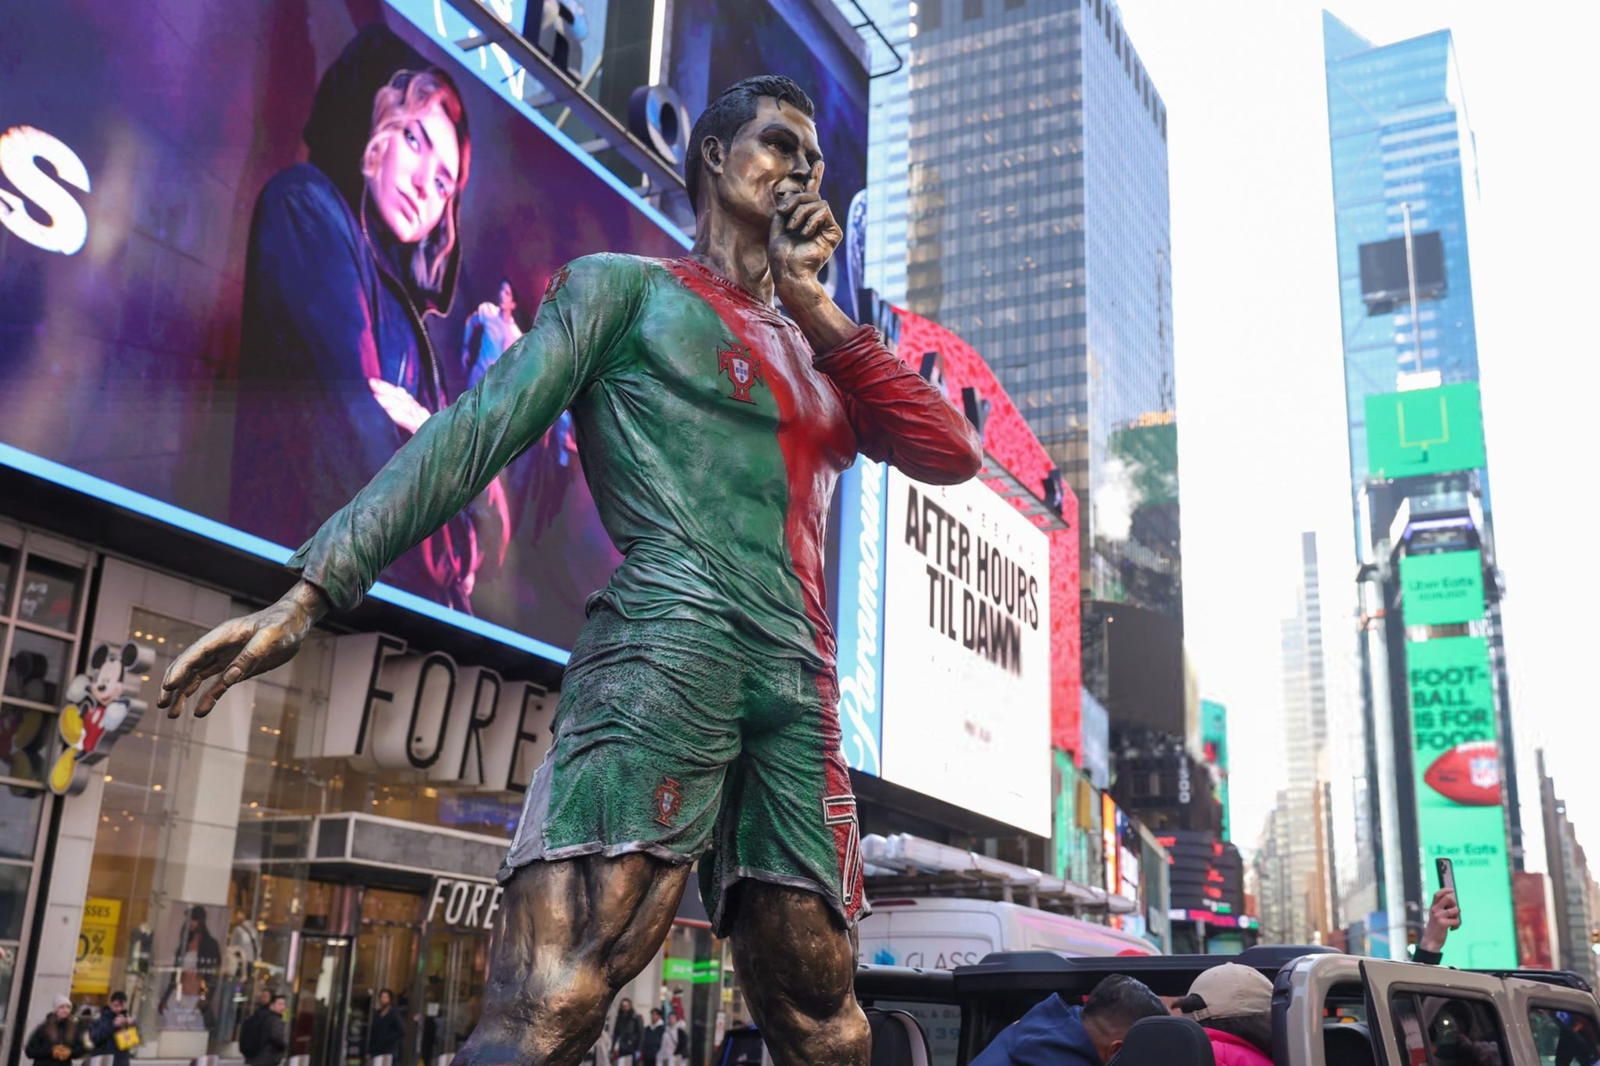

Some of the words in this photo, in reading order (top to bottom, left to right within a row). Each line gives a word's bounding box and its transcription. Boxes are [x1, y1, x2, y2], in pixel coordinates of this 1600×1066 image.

[0, 125, 91, 255] S
[905, 484, 970, 585] AFTER
[977, 535, 1038, 631] HOURS
[838, 453, 884, 778] Paramoun
[926, 563, 956, 641] TIL
[963, 588, 1022, 677] DAWN
[1411, 666, 1488, 687] FOOT-
[1413, 688, 1472, 708] BALL
[1415, 710, 1434, 728] IS
[1441, 707, 1490, 727] FOR
[427, 879, 504, 929] FORE
[823, 795, 860, 905] 7
